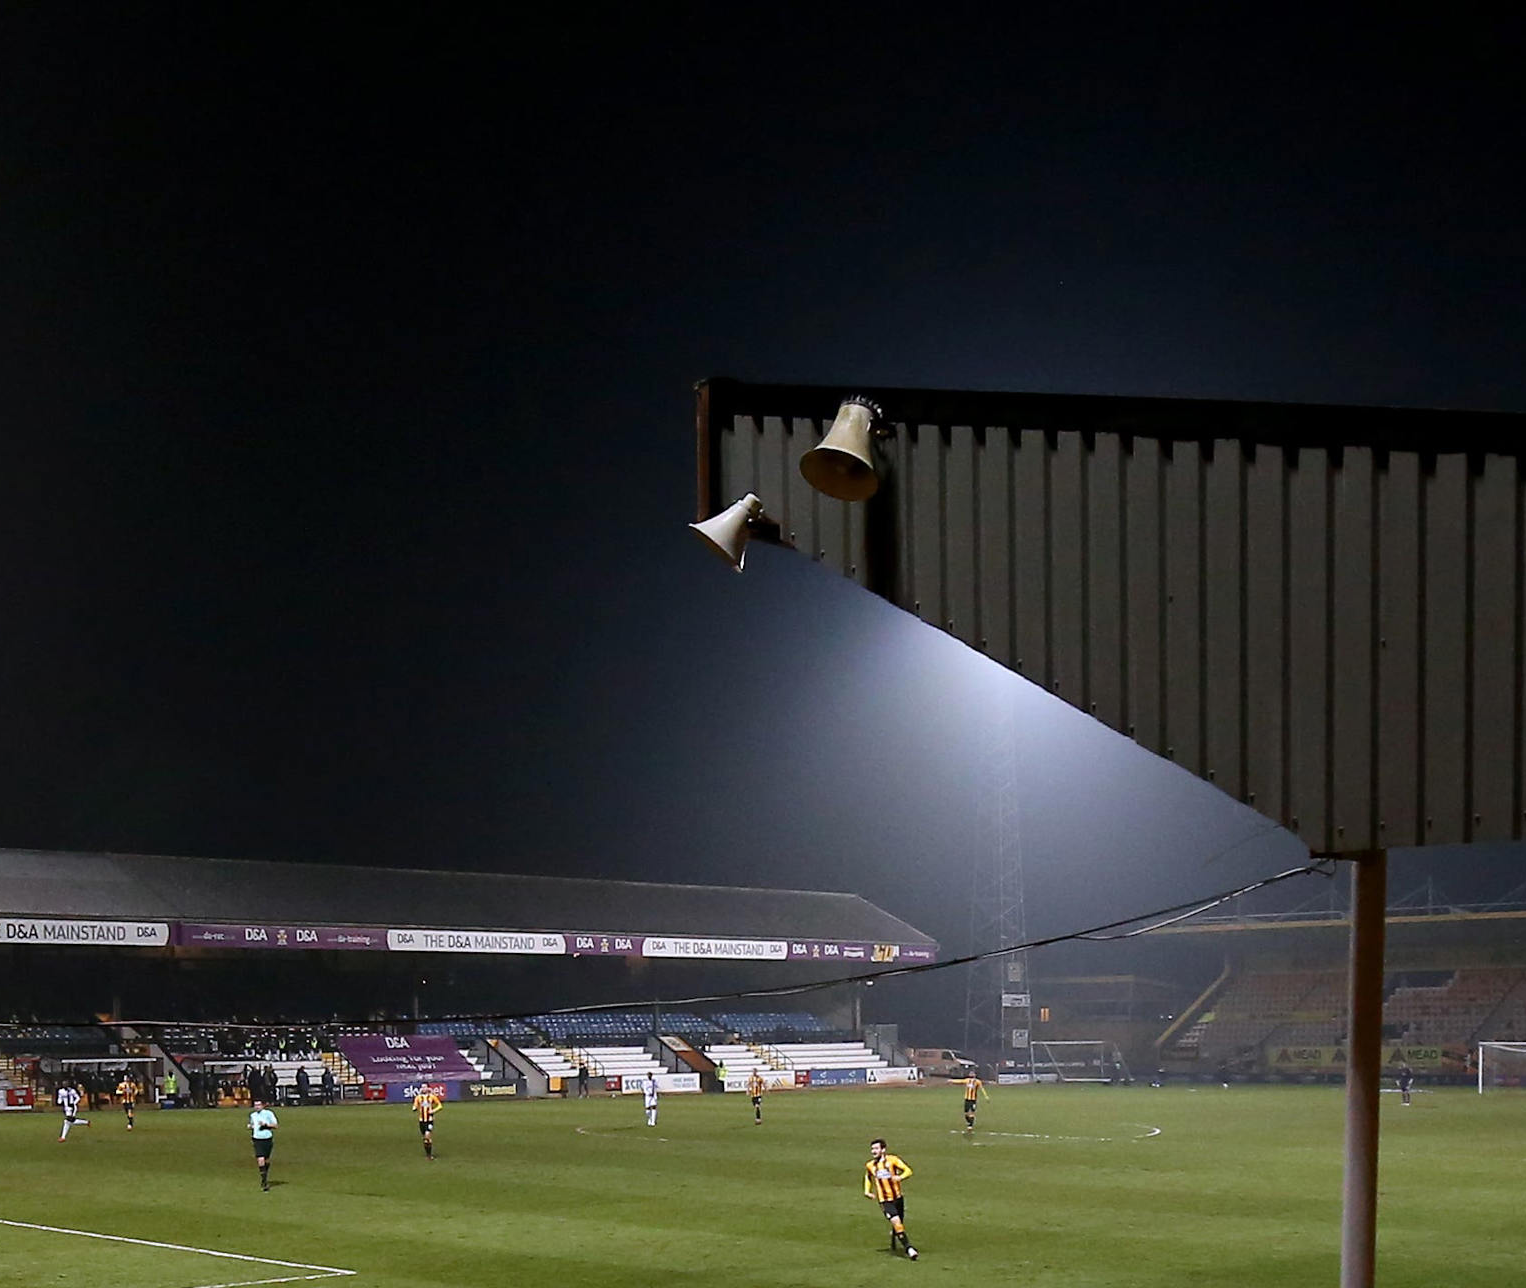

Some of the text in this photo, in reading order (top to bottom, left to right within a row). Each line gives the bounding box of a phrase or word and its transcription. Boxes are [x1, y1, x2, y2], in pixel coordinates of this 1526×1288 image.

[6, 924, 39, 940] D&A
[43, 924, 126, 941] MAINSTAND
[137, 927, 157, 938] D&A
[245, 928, 268, 942] D&A
[296, 929, 318, 943] D&A
[397, 934, 415, 944] D&A
[423, 934, 535, 950] THE D&A MAINSTAND
[543, 937, 558, 948] D&A
[576, 937, 594, 949] D&A
[615, 938, 632, 950] D&A
[652, 941, 666, 951] D&A
[673, 942, 764, 956] THE D&A MAINSTAND
[770, 944, 783, 954] D&A
[792, 943, 807, 955] D&A
[824, 945, 839, 956] D&A
[385, 1037, 410, 1049] D&A
[1407, 1049, 1438, 1060] MEAD
[404, 1085, 421, 1098] sky
[482, 1084, 517, 1095] hummel
